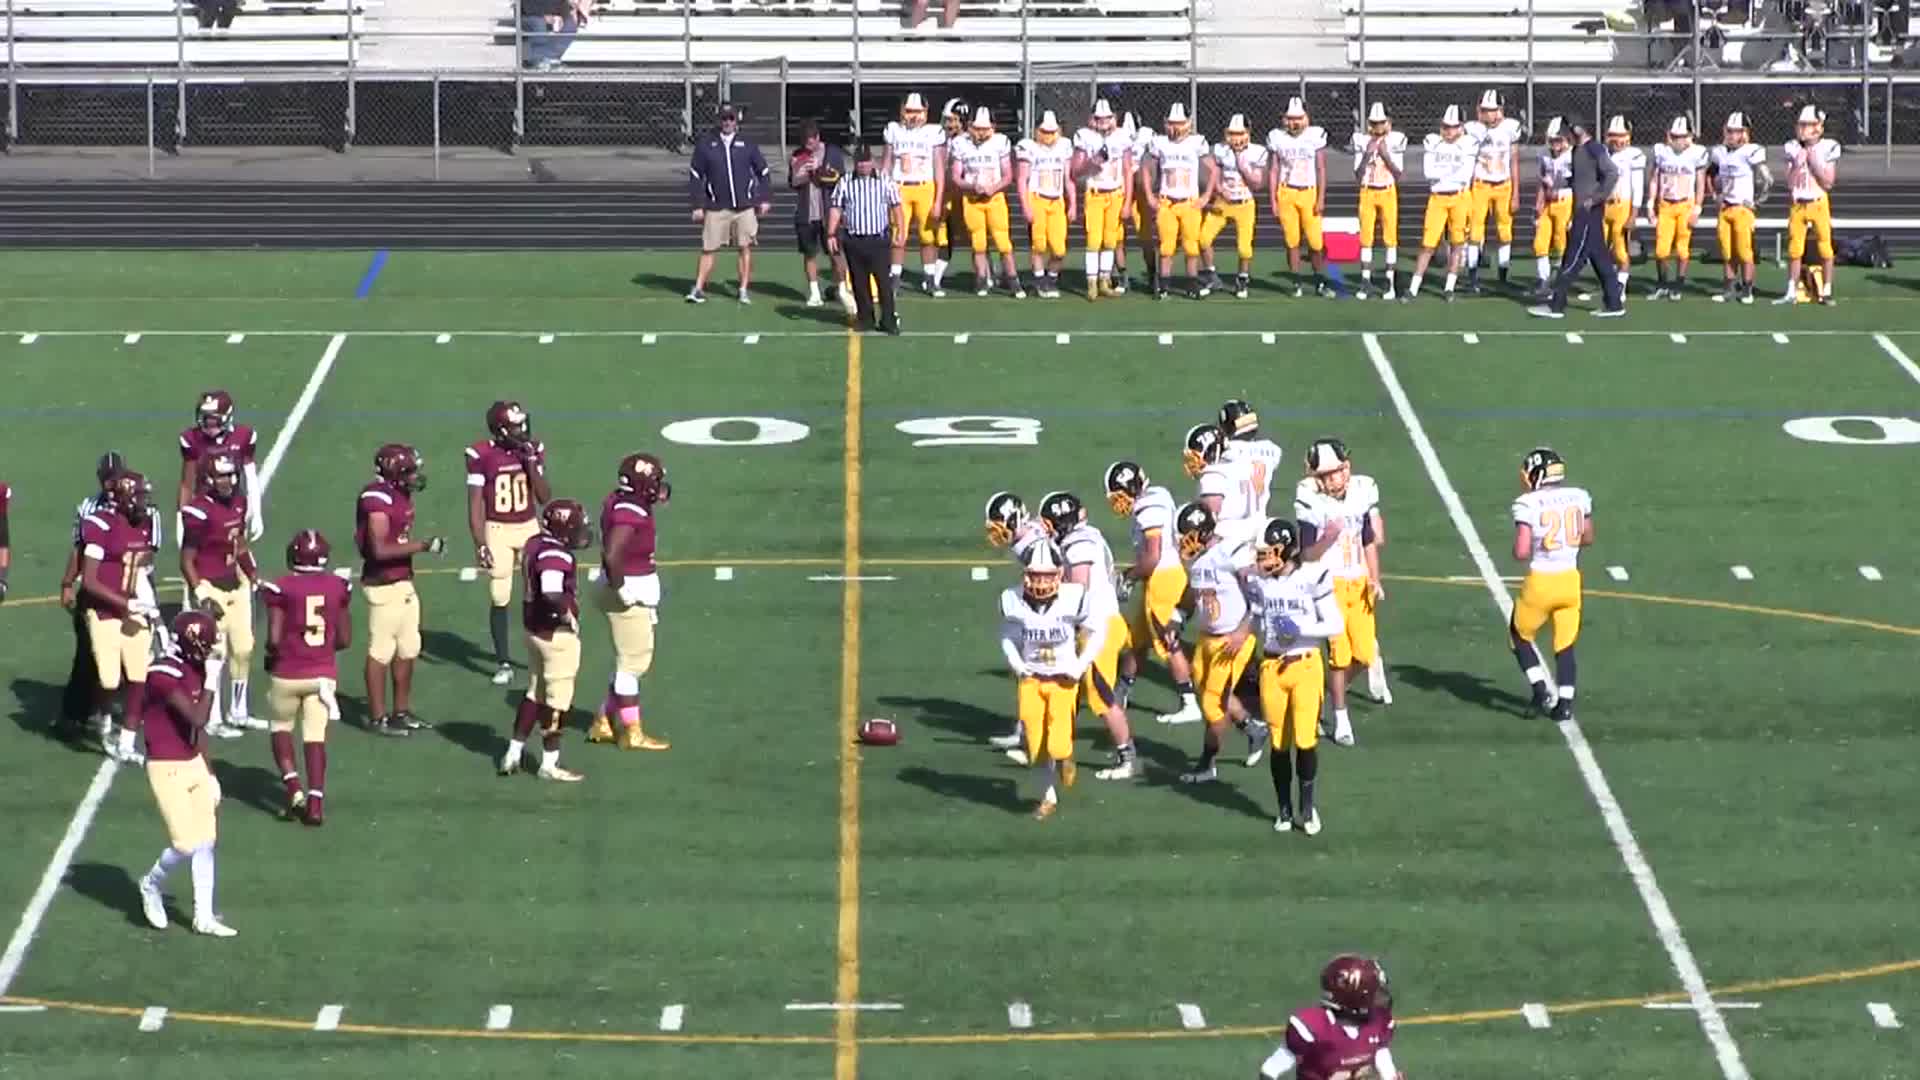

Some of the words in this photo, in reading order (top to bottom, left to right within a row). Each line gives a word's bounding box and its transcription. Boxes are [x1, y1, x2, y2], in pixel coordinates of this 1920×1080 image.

[495, 471, 529, 514] 80
[1540, 505, 1584, 551] 20
[304, 594, 326, 647] 5
